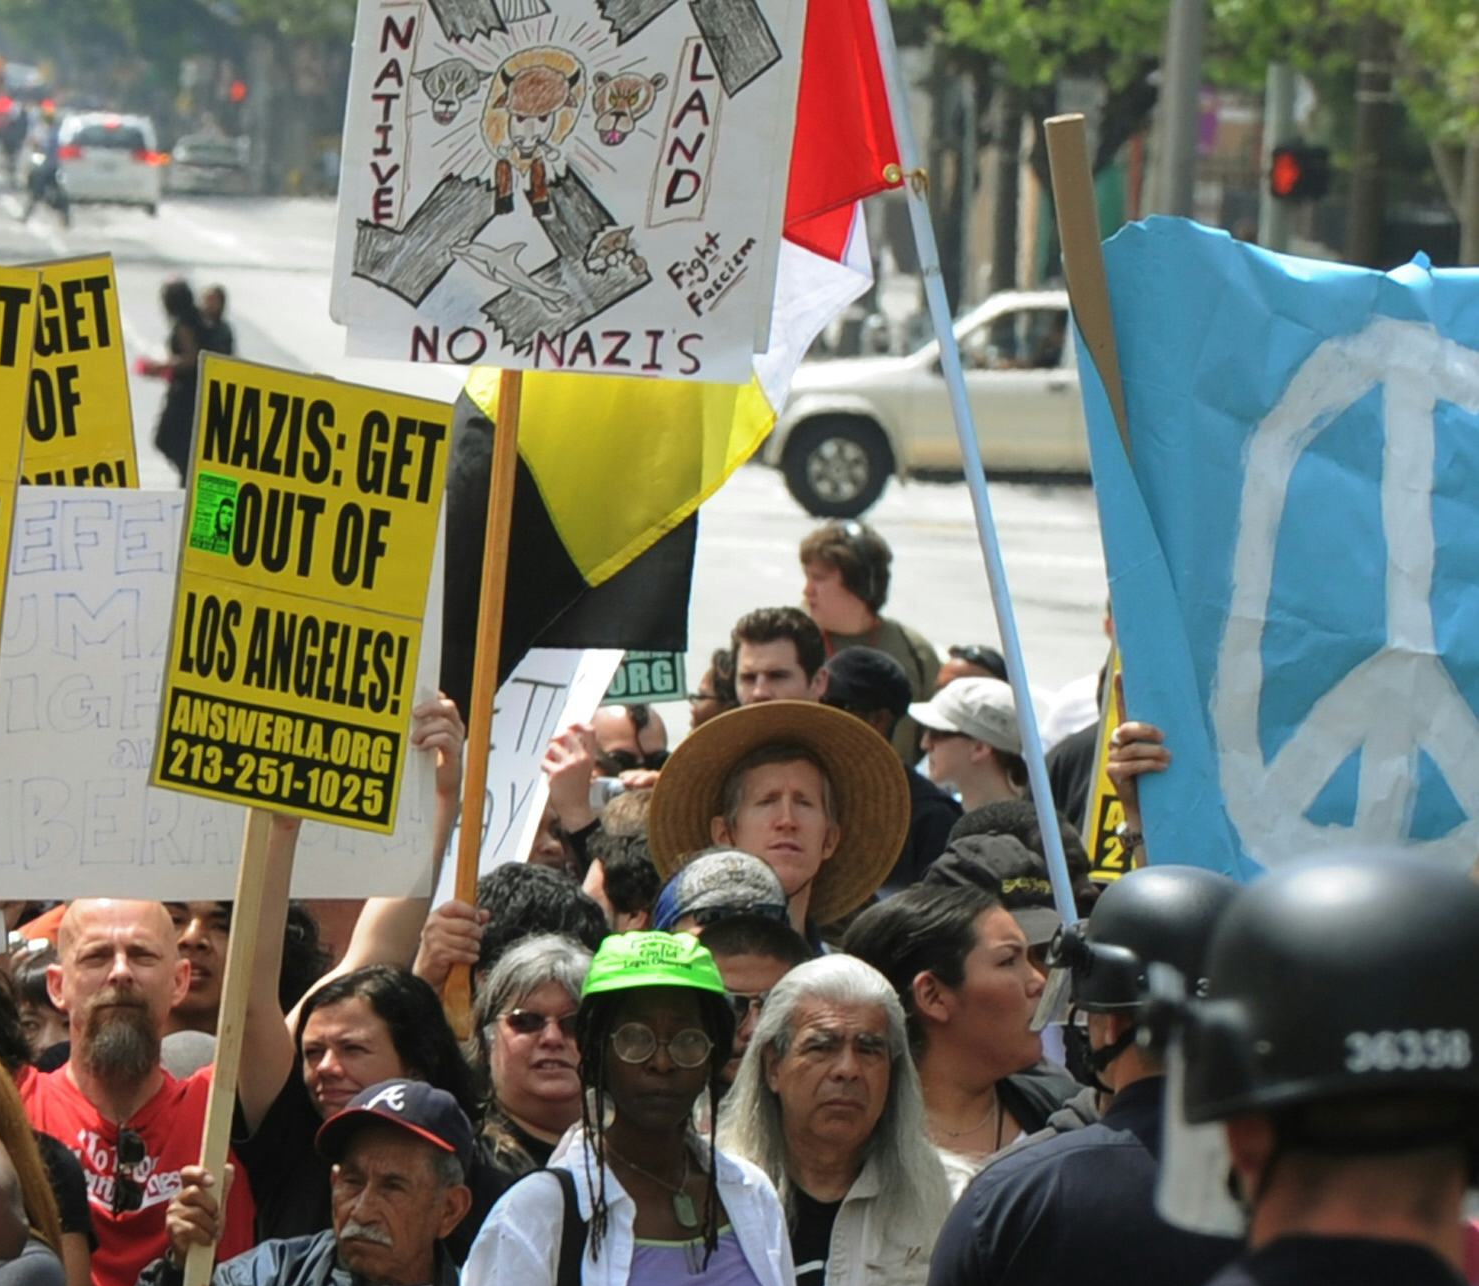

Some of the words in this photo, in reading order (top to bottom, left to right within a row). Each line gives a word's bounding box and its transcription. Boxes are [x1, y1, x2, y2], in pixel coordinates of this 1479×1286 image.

[371, 15, 416, 222] NATIVE
[666, 44, 715, 208] LAND
[666, 231, 721, 291] Fight
[35, 275, 110, 357] GET
[410, 326, 487, 365] NO
[26, 365, 81, 442] OF
[202, 379, 347, 486] NAZIS:
[356, 410, 445, 504] GET
[231, 483, 328, 577] OUT
[332, 502, 392, 589] OF
[179, 591, 244, 683] LOS
[243, 608, 409, 716] ANGELES!
[172, 696, 392, 775] ANSWERLA.ORG
[169, 739, 384, 818] 213-251-1025
